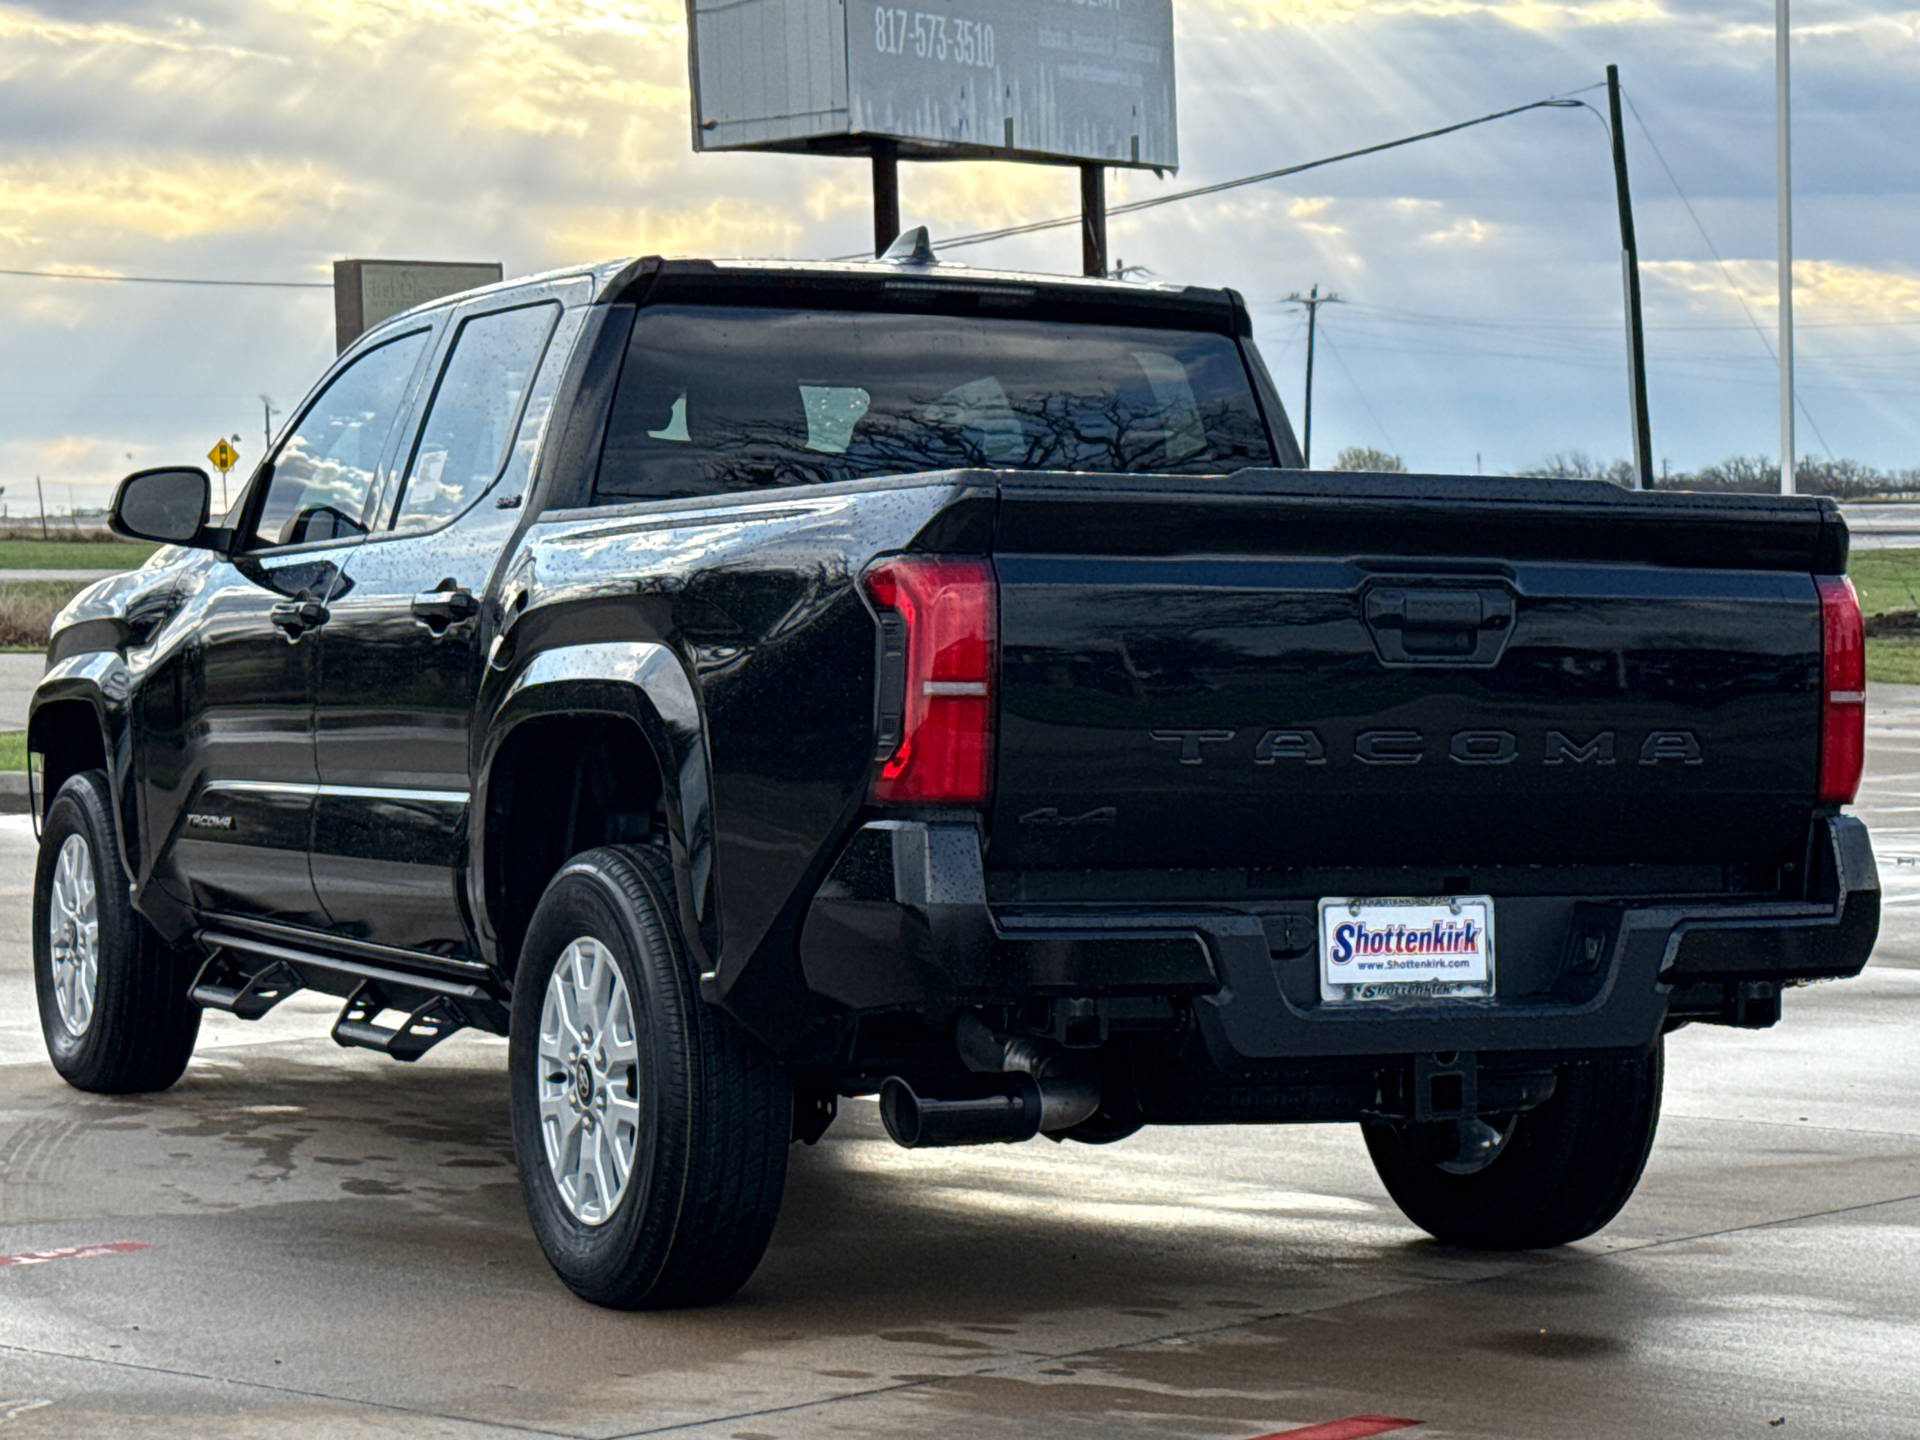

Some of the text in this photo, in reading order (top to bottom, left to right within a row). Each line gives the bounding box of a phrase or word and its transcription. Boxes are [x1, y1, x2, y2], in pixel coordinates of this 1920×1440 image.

[875, 6, 995, 69] 817-573-3510
[1411, 600, 1478, 618] TOYOTA
[1150, 729, 1704, 766] TACOMA
[187, 814, 237, 830] TACOMA
[1332, 920, 1481, 964] Shottenkirk
[1357, 959, 1470, 971] www.Shottenkirk.com
